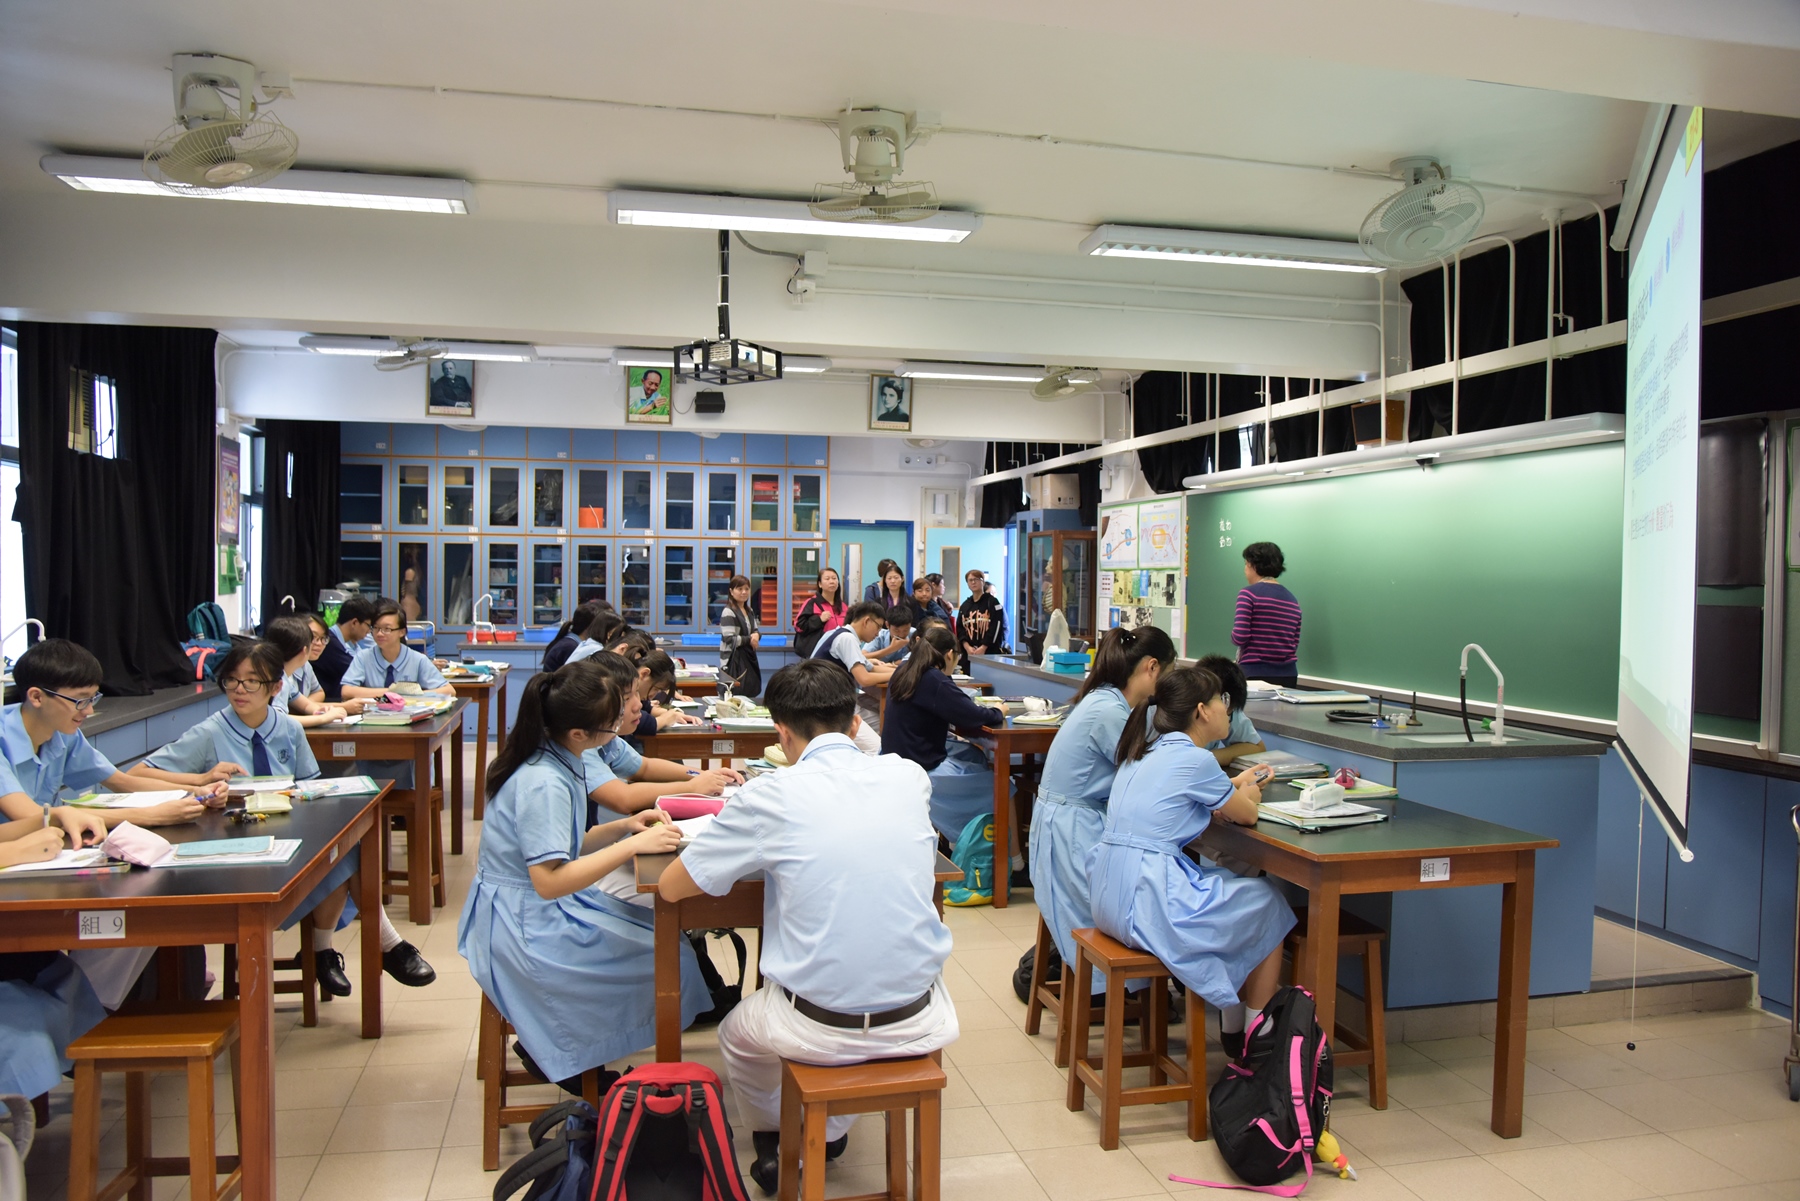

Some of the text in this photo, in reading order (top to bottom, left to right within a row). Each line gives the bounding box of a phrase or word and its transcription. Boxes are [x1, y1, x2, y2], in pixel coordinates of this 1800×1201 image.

[1422, 863, 1448, 878] 組 7
[81, 916, 123, 935] 組 9
